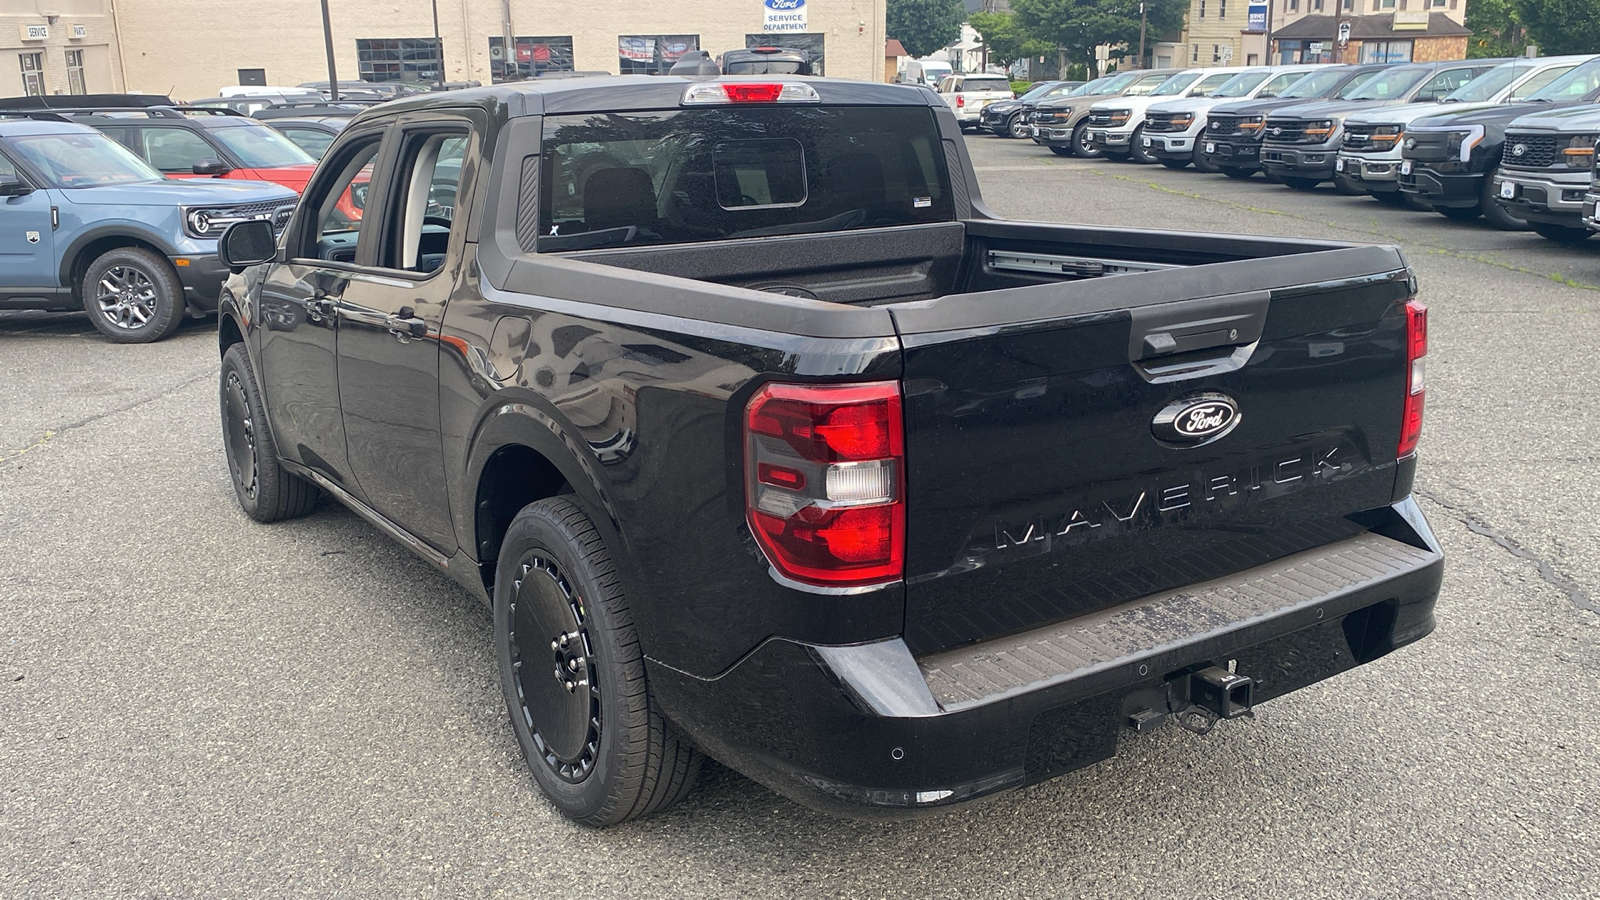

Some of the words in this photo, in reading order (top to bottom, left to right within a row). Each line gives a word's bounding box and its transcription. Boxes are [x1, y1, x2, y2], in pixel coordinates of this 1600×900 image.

[772, 0, 797, 8] Ford
[29, 27, 47, 37] SERVICE
[1186, 407, 1223, 431] Ford
[994, 447, 1341, 549] MAVERICK
